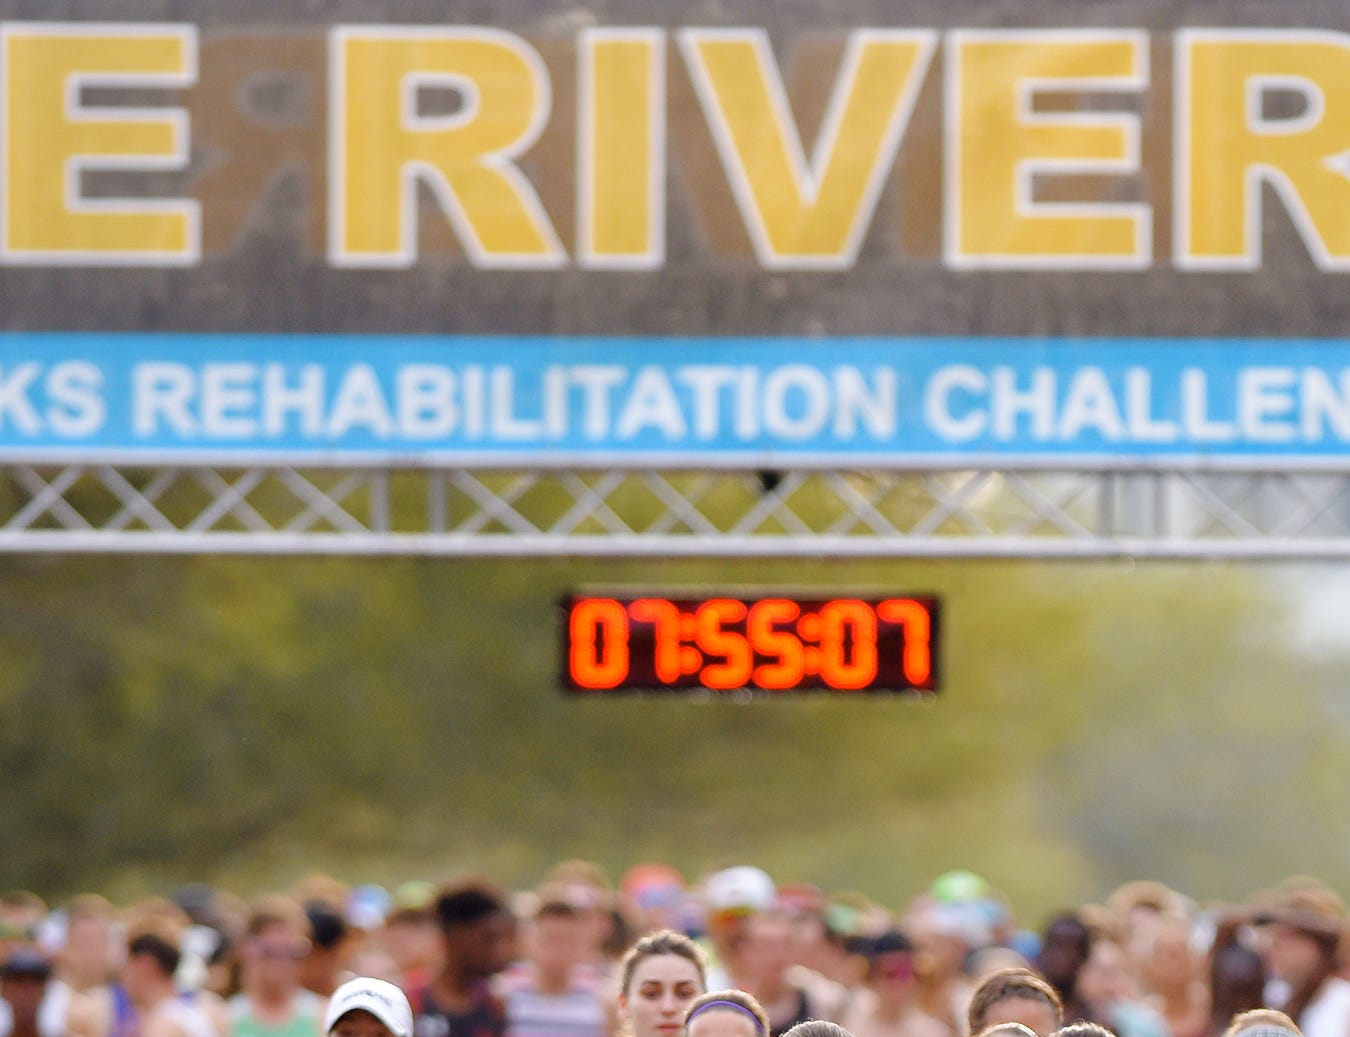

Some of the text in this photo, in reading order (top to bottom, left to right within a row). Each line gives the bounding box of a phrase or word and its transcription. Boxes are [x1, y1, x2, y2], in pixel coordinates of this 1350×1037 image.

[0, 22, 201, 267] E
[132, 361, 900, 442] REHABILITATION
[569, 597, 931, 690] 07:55:07
